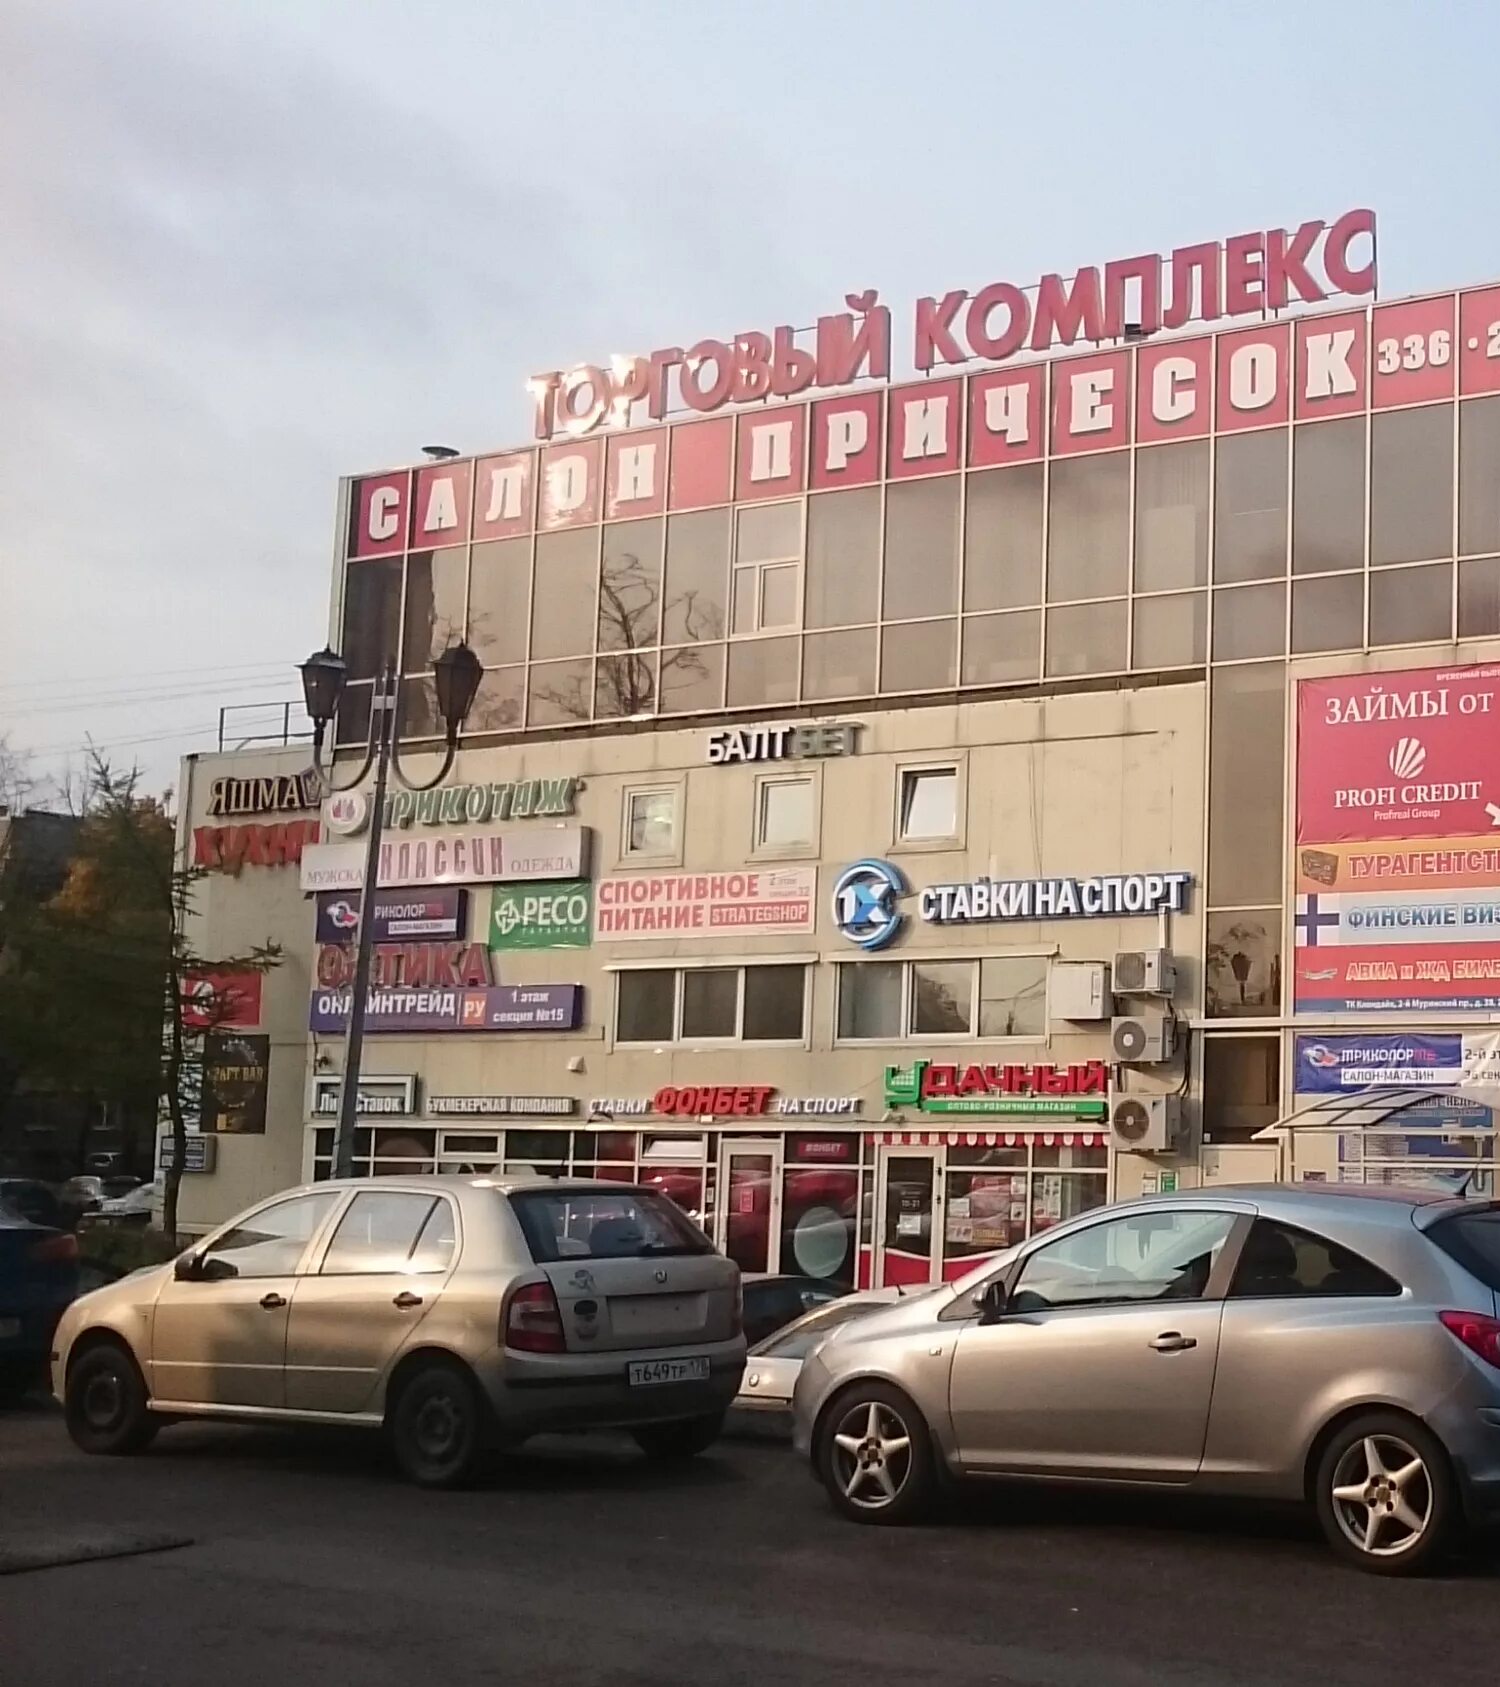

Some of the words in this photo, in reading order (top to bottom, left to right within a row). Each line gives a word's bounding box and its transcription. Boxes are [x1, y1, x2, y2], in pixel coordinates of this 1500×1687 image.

[527, 289, 891, 440] ТОРГОВЫЙ
[914, 208, 1377, 370] КОМПЛЕКС
[368, 441, 657, 541] САЛОН
[750, 328, 1358, 483] ПРИЧЕСОК
[1325, 687, 1449, 725] ЗАЙМЫ
[206, 775, 302, 816] ЯШМА
[1334, 788, 1396, 808] PROFI
[1401, 781, 1482, 804] CREDIT
[1411, 808, 1441, 819] Group
[306, 869, 363, 884] МУЖСКА
[511, 857, 575, 873] ОДЕЖДА
[600, 874, 760, 905] СПОРТИВНОЕ
[919, 886, 1029, 921] СТАВКИ
[1036, 880, 1079, 913] НА
[1079, 871, 1187, 911] СПОРТ
[374, 903, 426, 919] РИКОЛОР
[523, 895, 588, 926] РЕСО
[599, 904, 704, 931] ПИТАНИЕ
[712, 905, 807, 924] STRATEGSHOP
[1347, 905, 1457, 930] ФИНСКИЕ
[1345, 963, 1397, 981] АВИА
[1415, 962, 1450, 982] ЖД
[318, 991, 456, 1017] ОНЛЙНТРЕЙД
[463, 1000, 487, 1018] РУ
[885, 1059, 1108, 1108] УДАЧНЫЙ
[1343, 1070, 1434, 1082] САЛОН-МАГАЗИН
[589, 1099, 647, 1113] СТАВКИ
[654, 1087, 770, 1115] ФОНБЕТ
[778, 1099, 798, 1113] НА
[803, 1097, 859, 1113] СПОРТ
